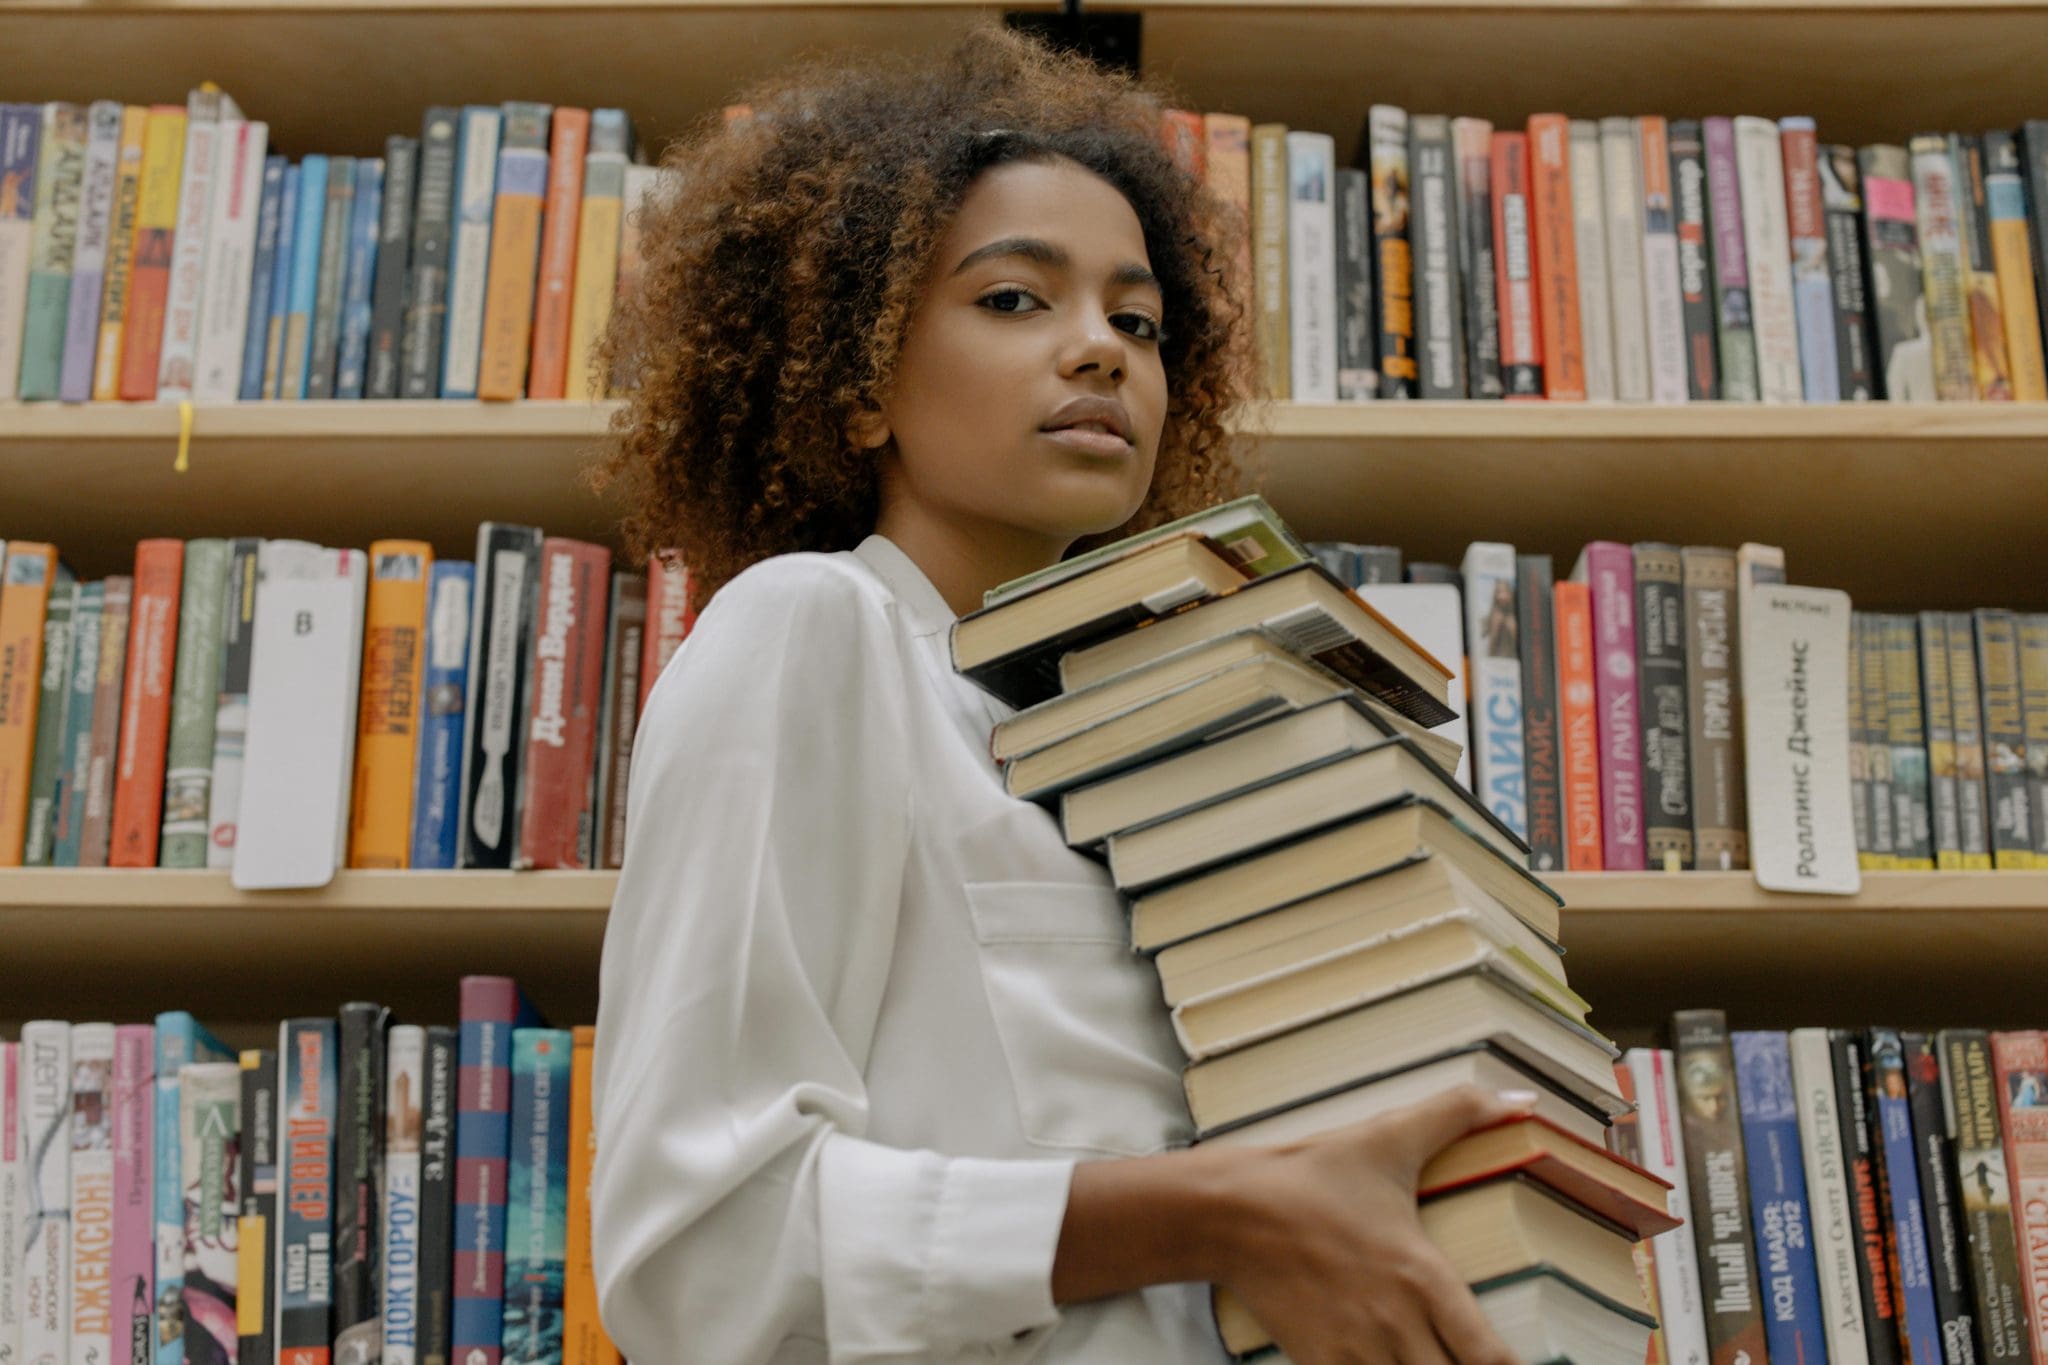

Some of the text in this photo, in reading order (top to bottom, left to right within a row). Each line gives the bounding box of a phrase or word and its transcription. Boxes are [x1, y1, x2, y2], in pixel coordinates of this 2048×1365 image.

[531, 553, 575, 745] Джон Вердон
[1697, 589, 1731, 739] ГОРОД ПУСТЫХ
[1785, 640, 1810, 756] Джеймс
[1487, 694, 1528, 833] РАЙС
[1527, 708, 1554, 780] РАЙС
[1569, 712, 1596, 845] КЭТИ РАЙХ
[1610, 690, 1638, 844] КЭТИ РАЙХ
[1533, 787, 1557, 846] ЭНН
[1789, 765, 1817, 878] Роллинс
[290, 1119, 329, 1220] ДИВЕР
[1784, 1200, 1805, 1248] 2012
[1812, 1089, 1859, 1332] Джастин Скотт БУЙСТВО
[74, 1185, 112, 1334] ДЖЕКСОН
[387, 1191, 415, 1346] ДОКТОРОУ
[1762, 1201, 1790, 1272] МАЙЯ:
[1774, 1275, 1795, 1321] КОД
[1853, 1159, 1892, 1318] ЗАЛИВ Гавана
